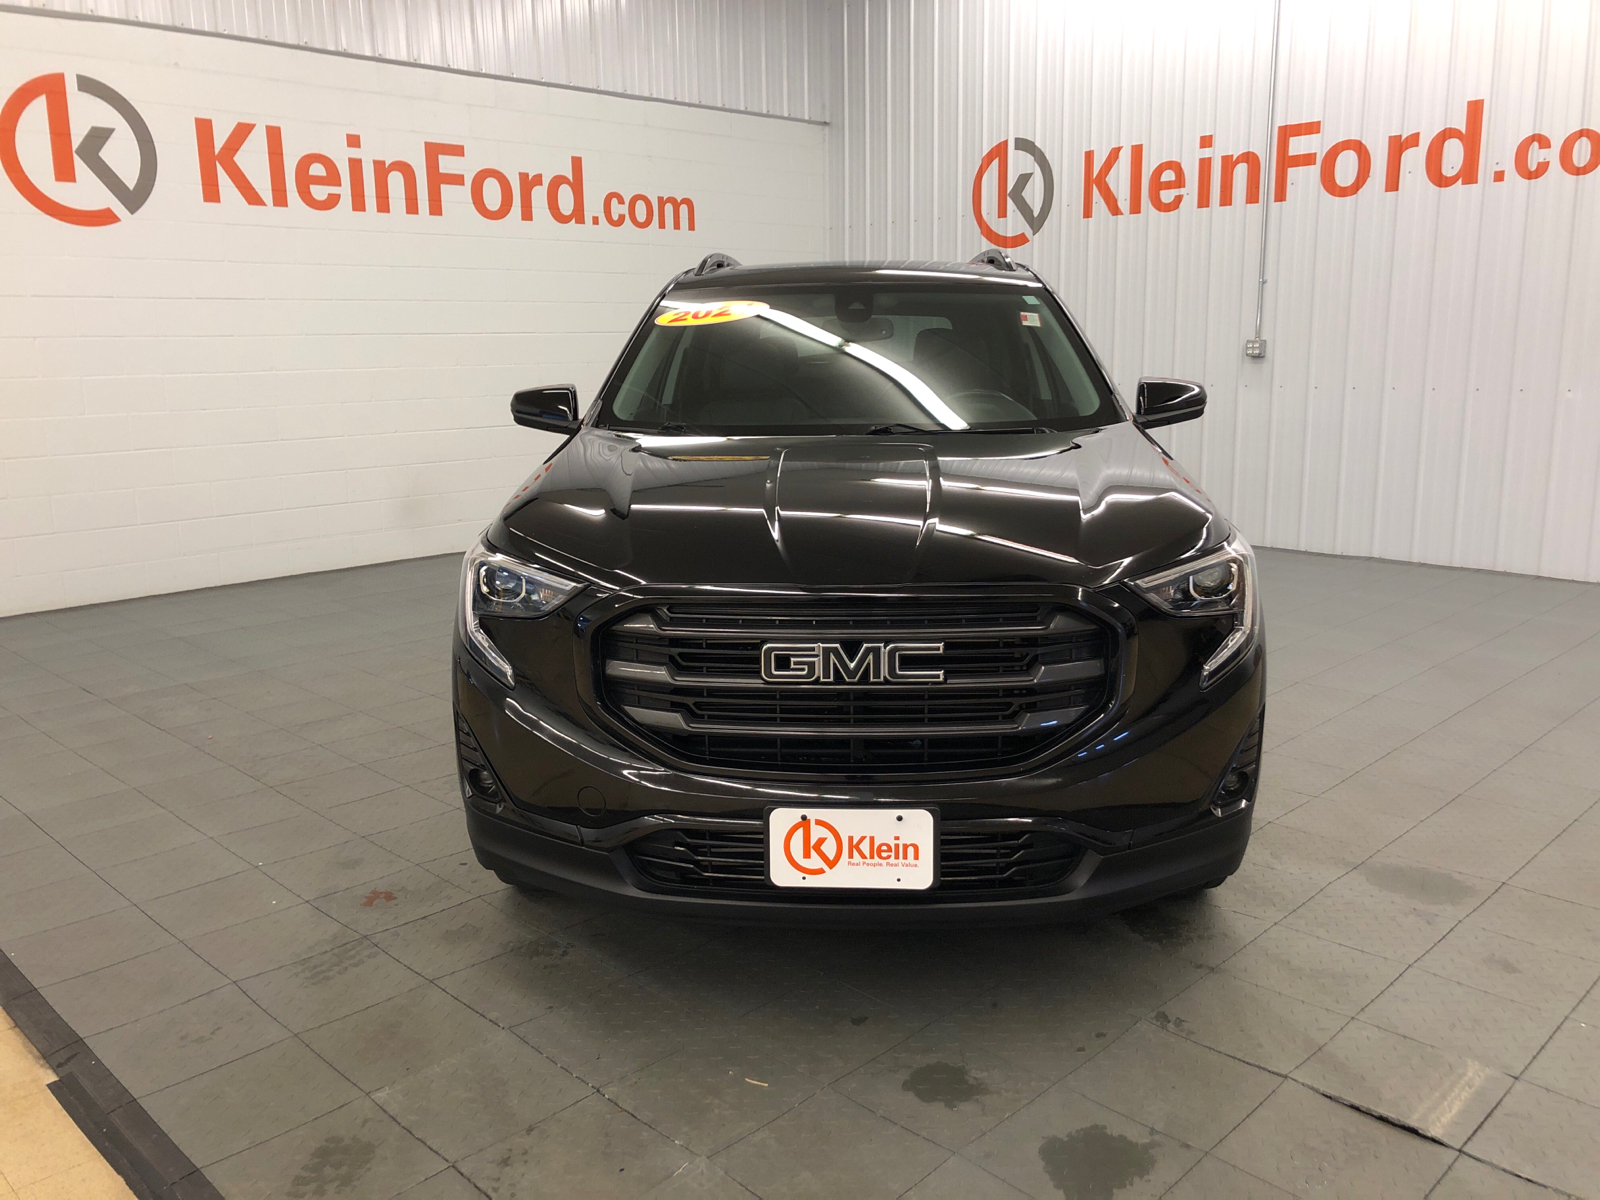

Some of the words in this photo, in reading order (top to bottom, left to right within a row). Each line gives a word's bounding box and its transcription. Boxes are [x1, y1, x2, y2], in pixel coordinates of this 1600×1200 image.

[195, 117, 696, 232] KleinFord.com
[761, 643, 945, 682] GMC
[847, 835, 920, 861] Klein
